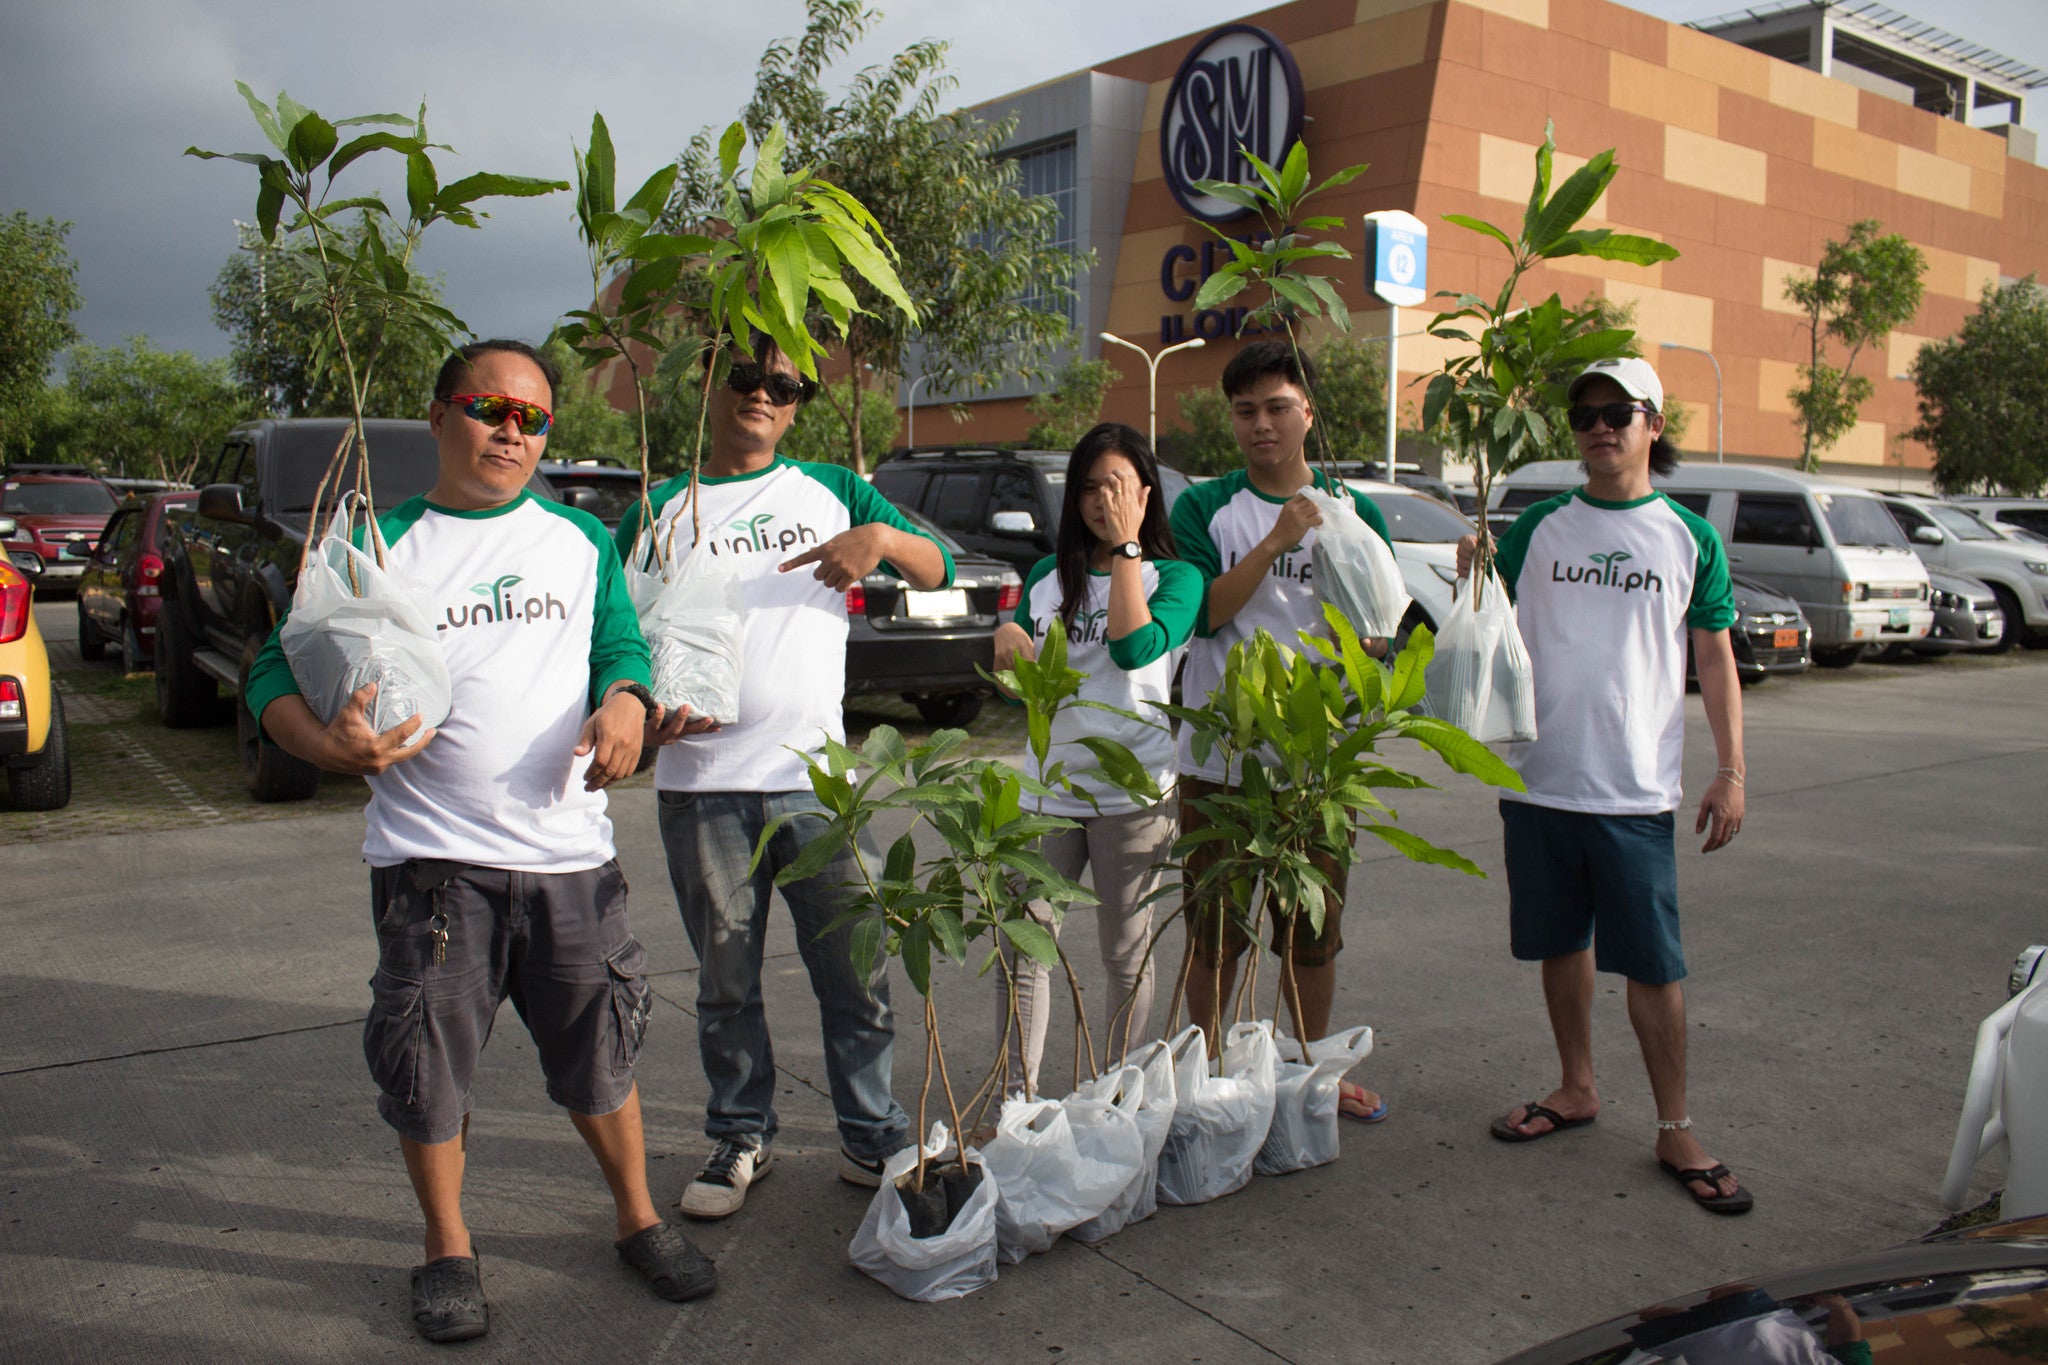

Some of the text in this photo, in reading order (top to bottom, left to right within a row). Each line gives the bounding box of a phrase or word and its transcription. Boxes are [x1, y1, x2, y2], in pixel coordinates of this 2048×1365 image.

[1174, 46, 1272, 196] SM
[1396, 254, 1409, 274] 12
[1160, 304, 1294, 344] ILOIL
